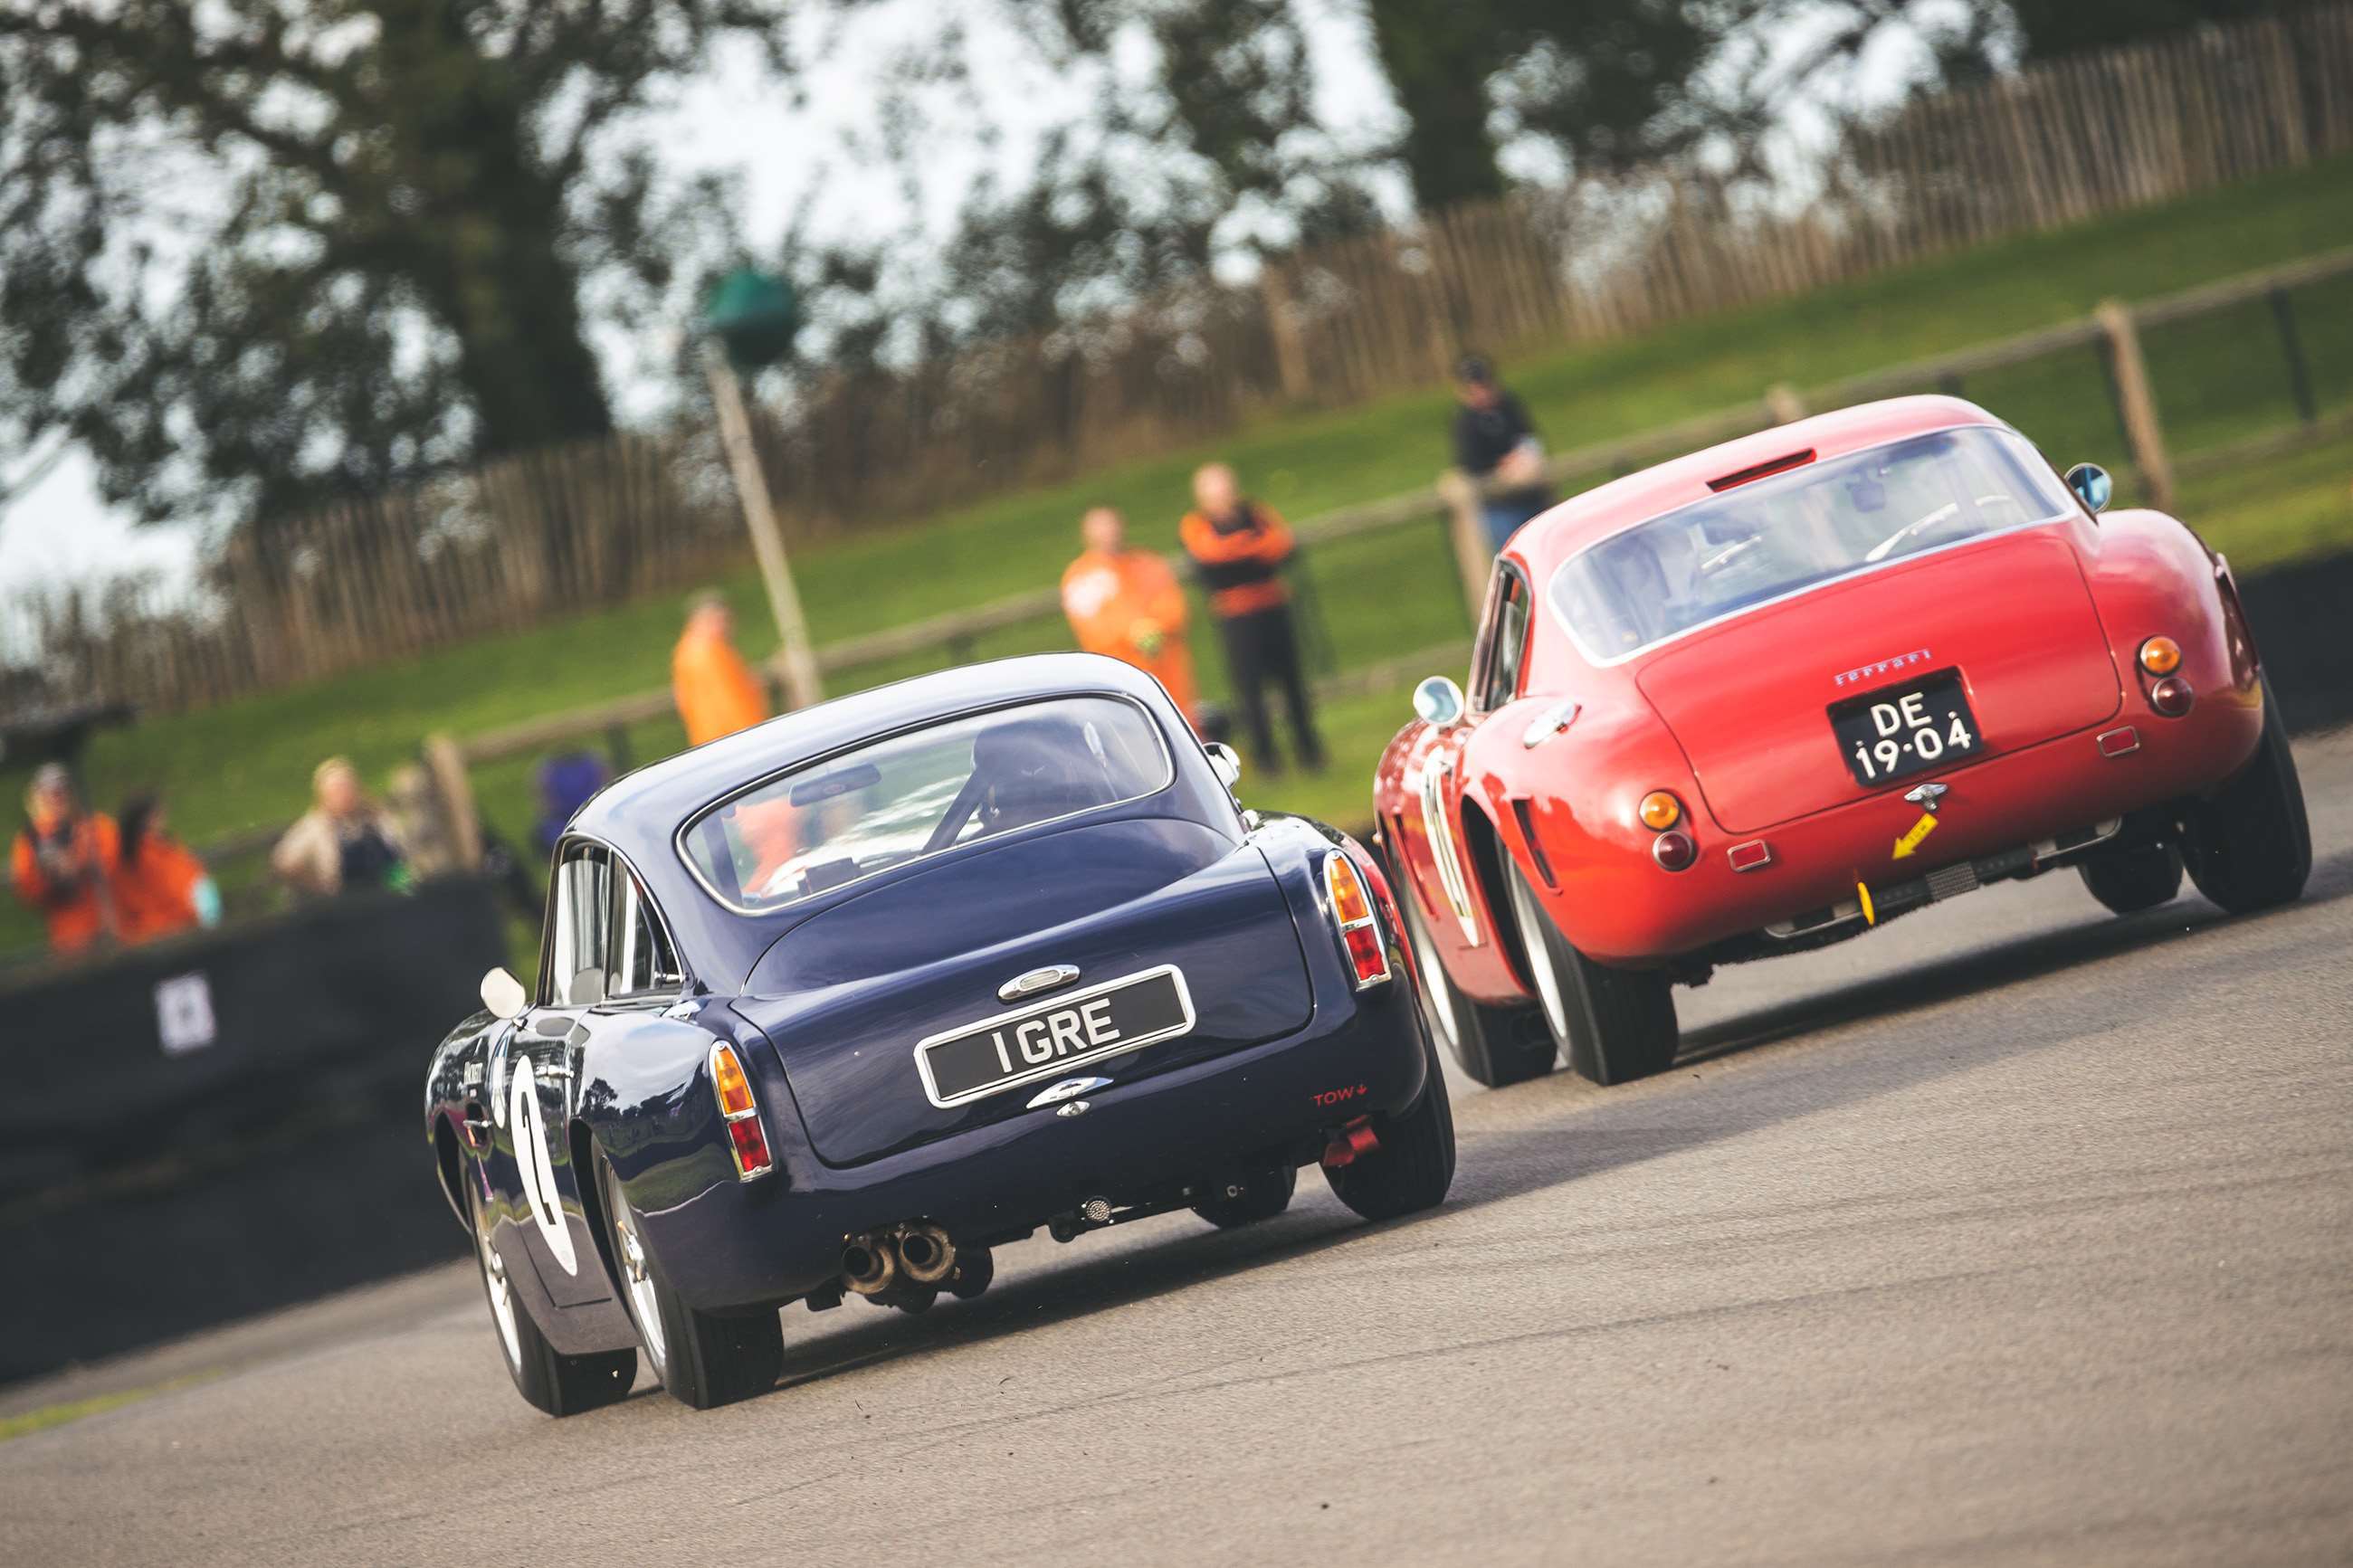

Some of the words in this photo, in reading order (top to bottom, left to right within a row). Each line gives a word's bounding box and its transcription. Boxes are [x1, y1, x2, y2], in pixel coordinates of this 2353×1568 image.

[1870, 691, 1932, 737] DE
[991, 1031, 1013, 1074] 1
[1015, 997, 1121, 1065] GRE
[1312, 1086, 1355, 1108] TOW
